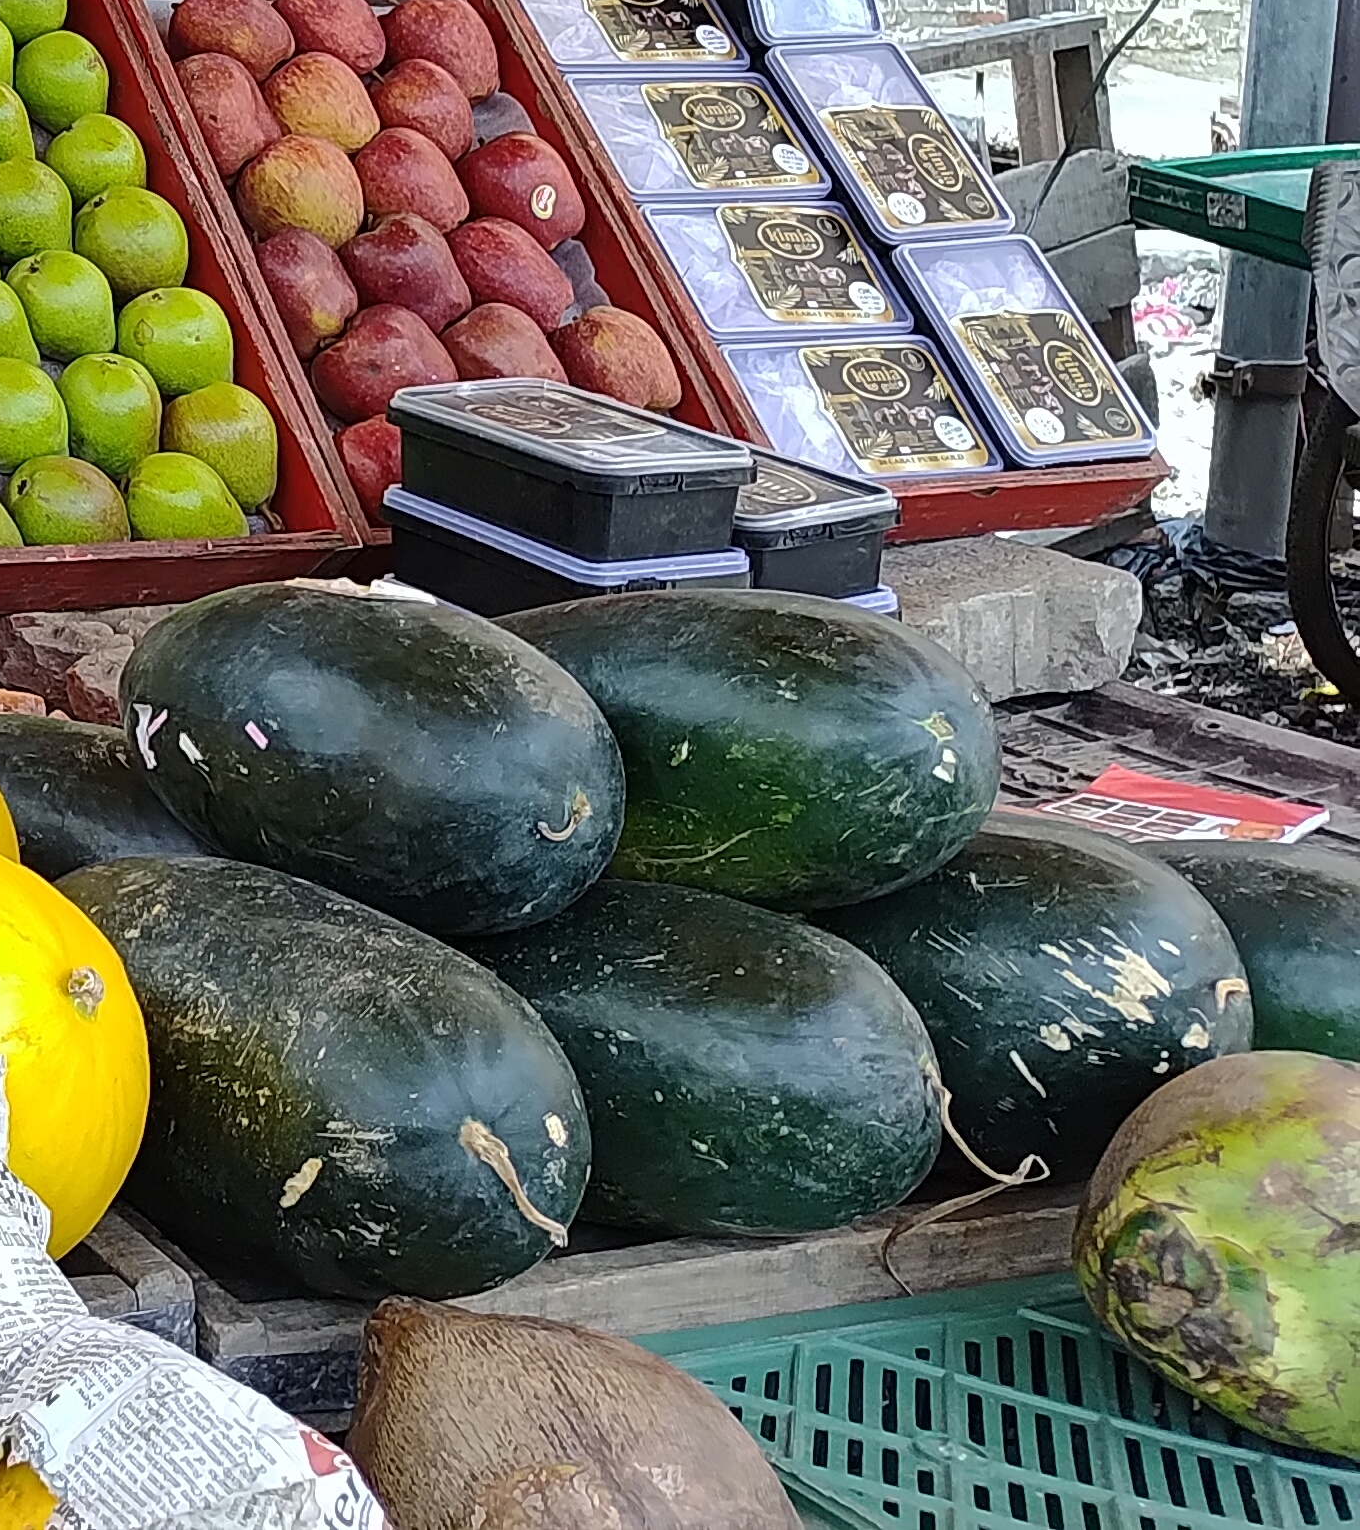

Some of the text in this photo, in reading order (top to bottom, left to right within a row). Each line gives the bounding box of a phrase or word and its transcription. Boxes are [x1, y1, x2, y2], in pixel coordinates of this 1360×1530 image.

[689, 101, 737, 117] kimia
[924, 139, 959, 189] kimia
[767, 228, 815, 247] kimia
[852, 365, 900, 384] kimia
[1056, 346, 1094, 400] kimia
[917, 453, 939, 463] PURE
[940, 452, 965, 463] GOLD
